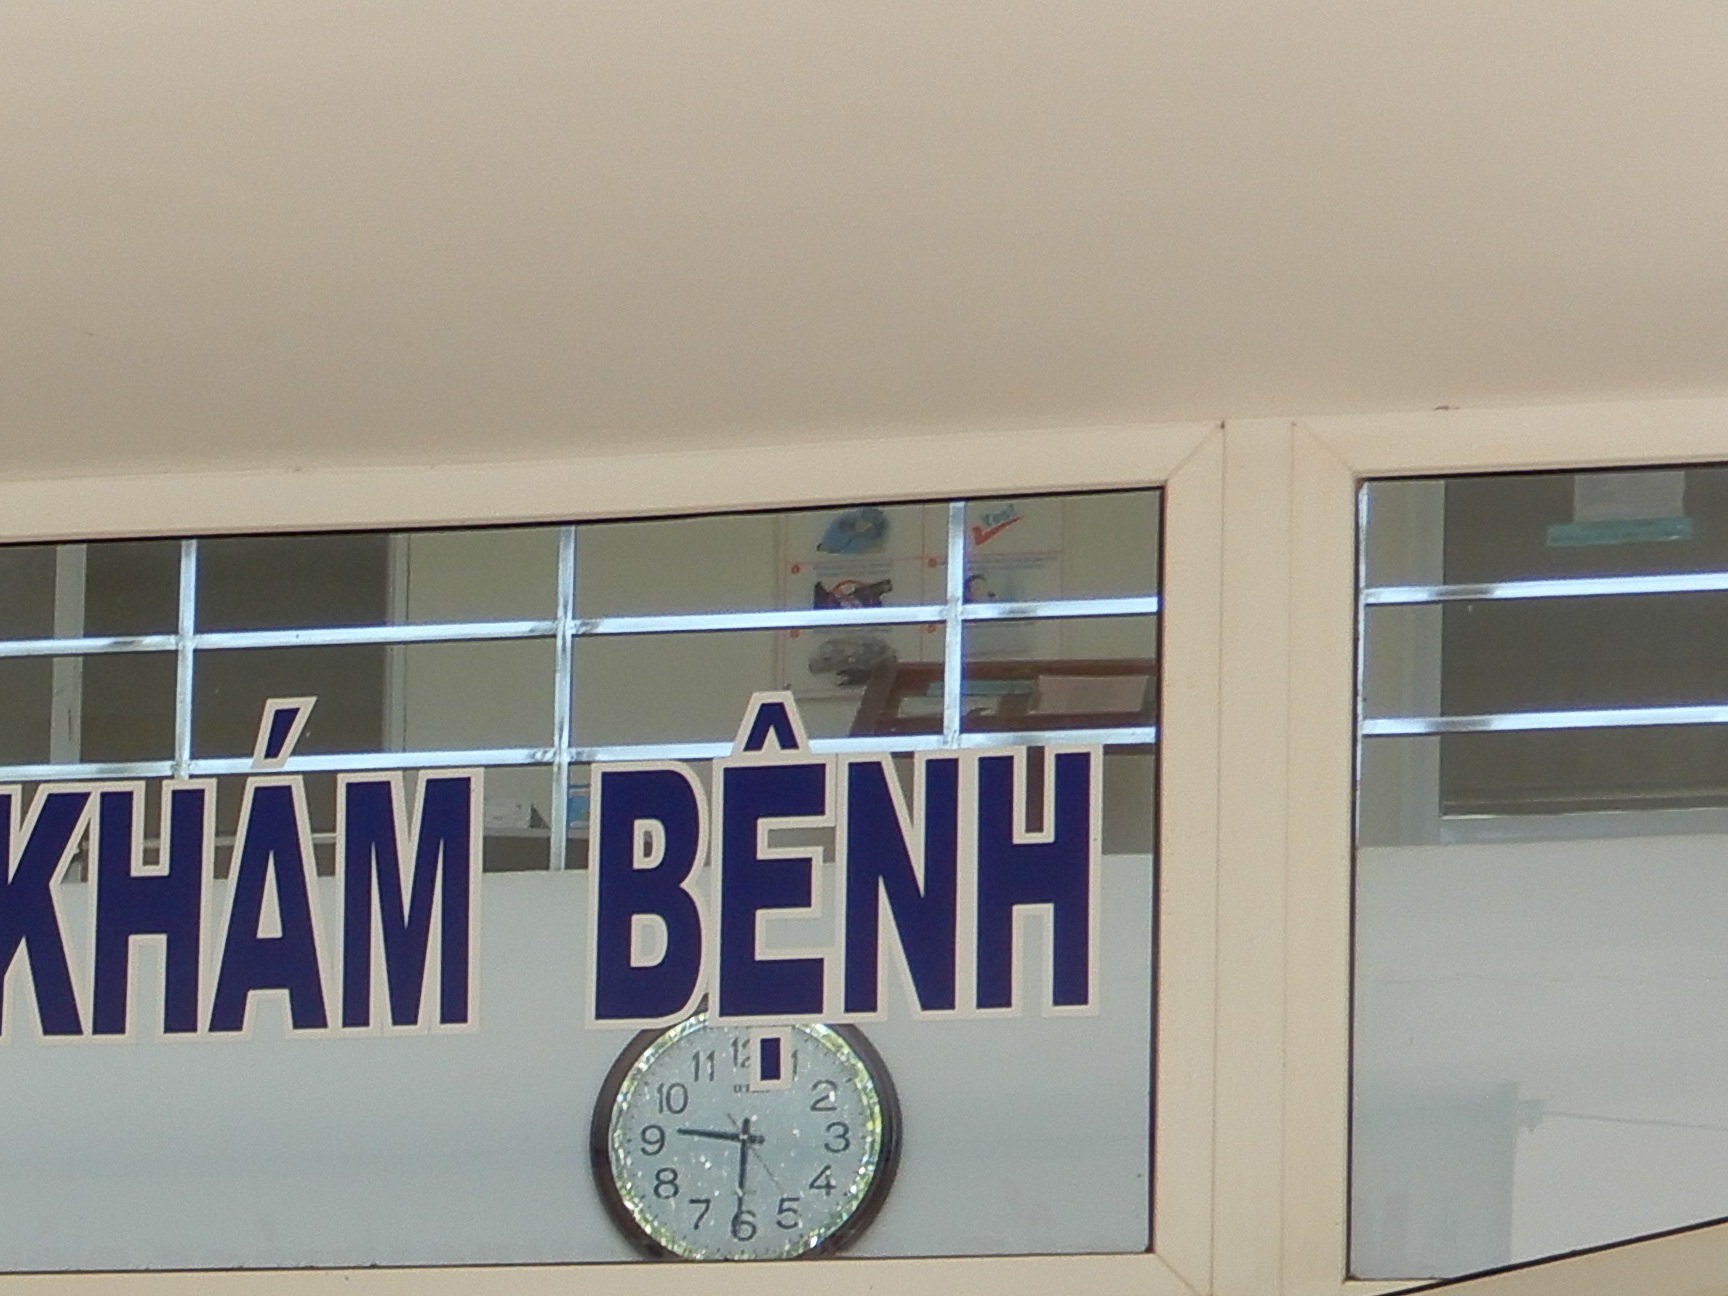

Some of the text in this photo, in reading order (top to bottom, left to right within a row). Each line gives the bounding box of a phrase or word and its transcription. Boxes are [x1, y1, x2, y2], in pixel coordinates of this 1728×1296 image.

[594, 701, 1093, 1081] BỆNH
[693, 1050, 716, 1083] 11
[656, 1082, 689, 1114] 10
[810, 1079, 839, 1112] 2
[640, 1125, 666, 1156] 9
[824, 1121, 851, 1154] 3
[653, 1167, 680, 1200] 8
[809, 1164, 837, 1197] 4
[689, 1198, 712, 1231] 7
[731, 1209, 758, 1242] 6
[776, 1197, 801, 1230] 5
